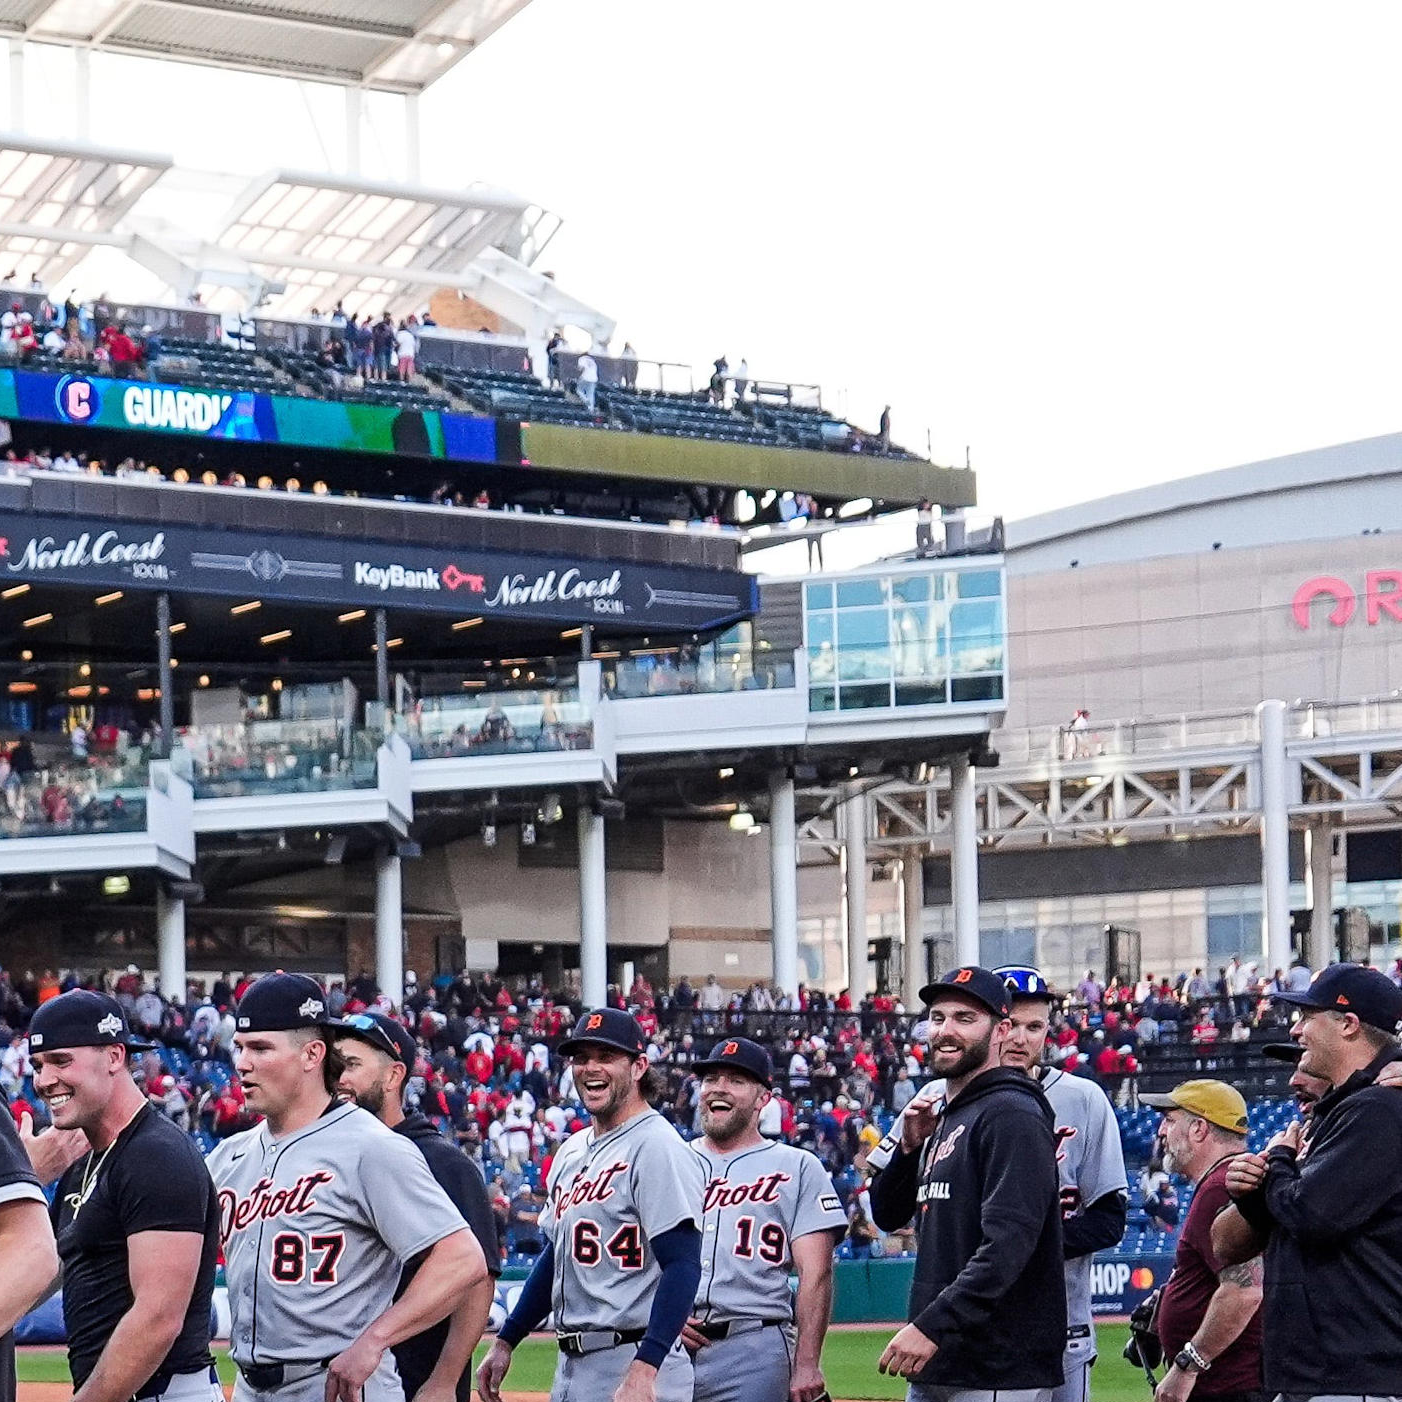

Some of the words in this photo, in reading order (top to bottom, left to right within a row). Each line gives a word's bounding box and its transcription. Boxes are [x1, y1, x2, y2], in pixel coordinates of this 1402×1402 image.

[123, 385, 233, 431] GUARDI
[355, 562, 441, 591] KeyBank
[217, 1169, 335, 1248] Detroit
[269, 1231, 346, 1285] 87
[571, 1217, 644, 1270] 64
[732, 1214, 788, 1266] 19
